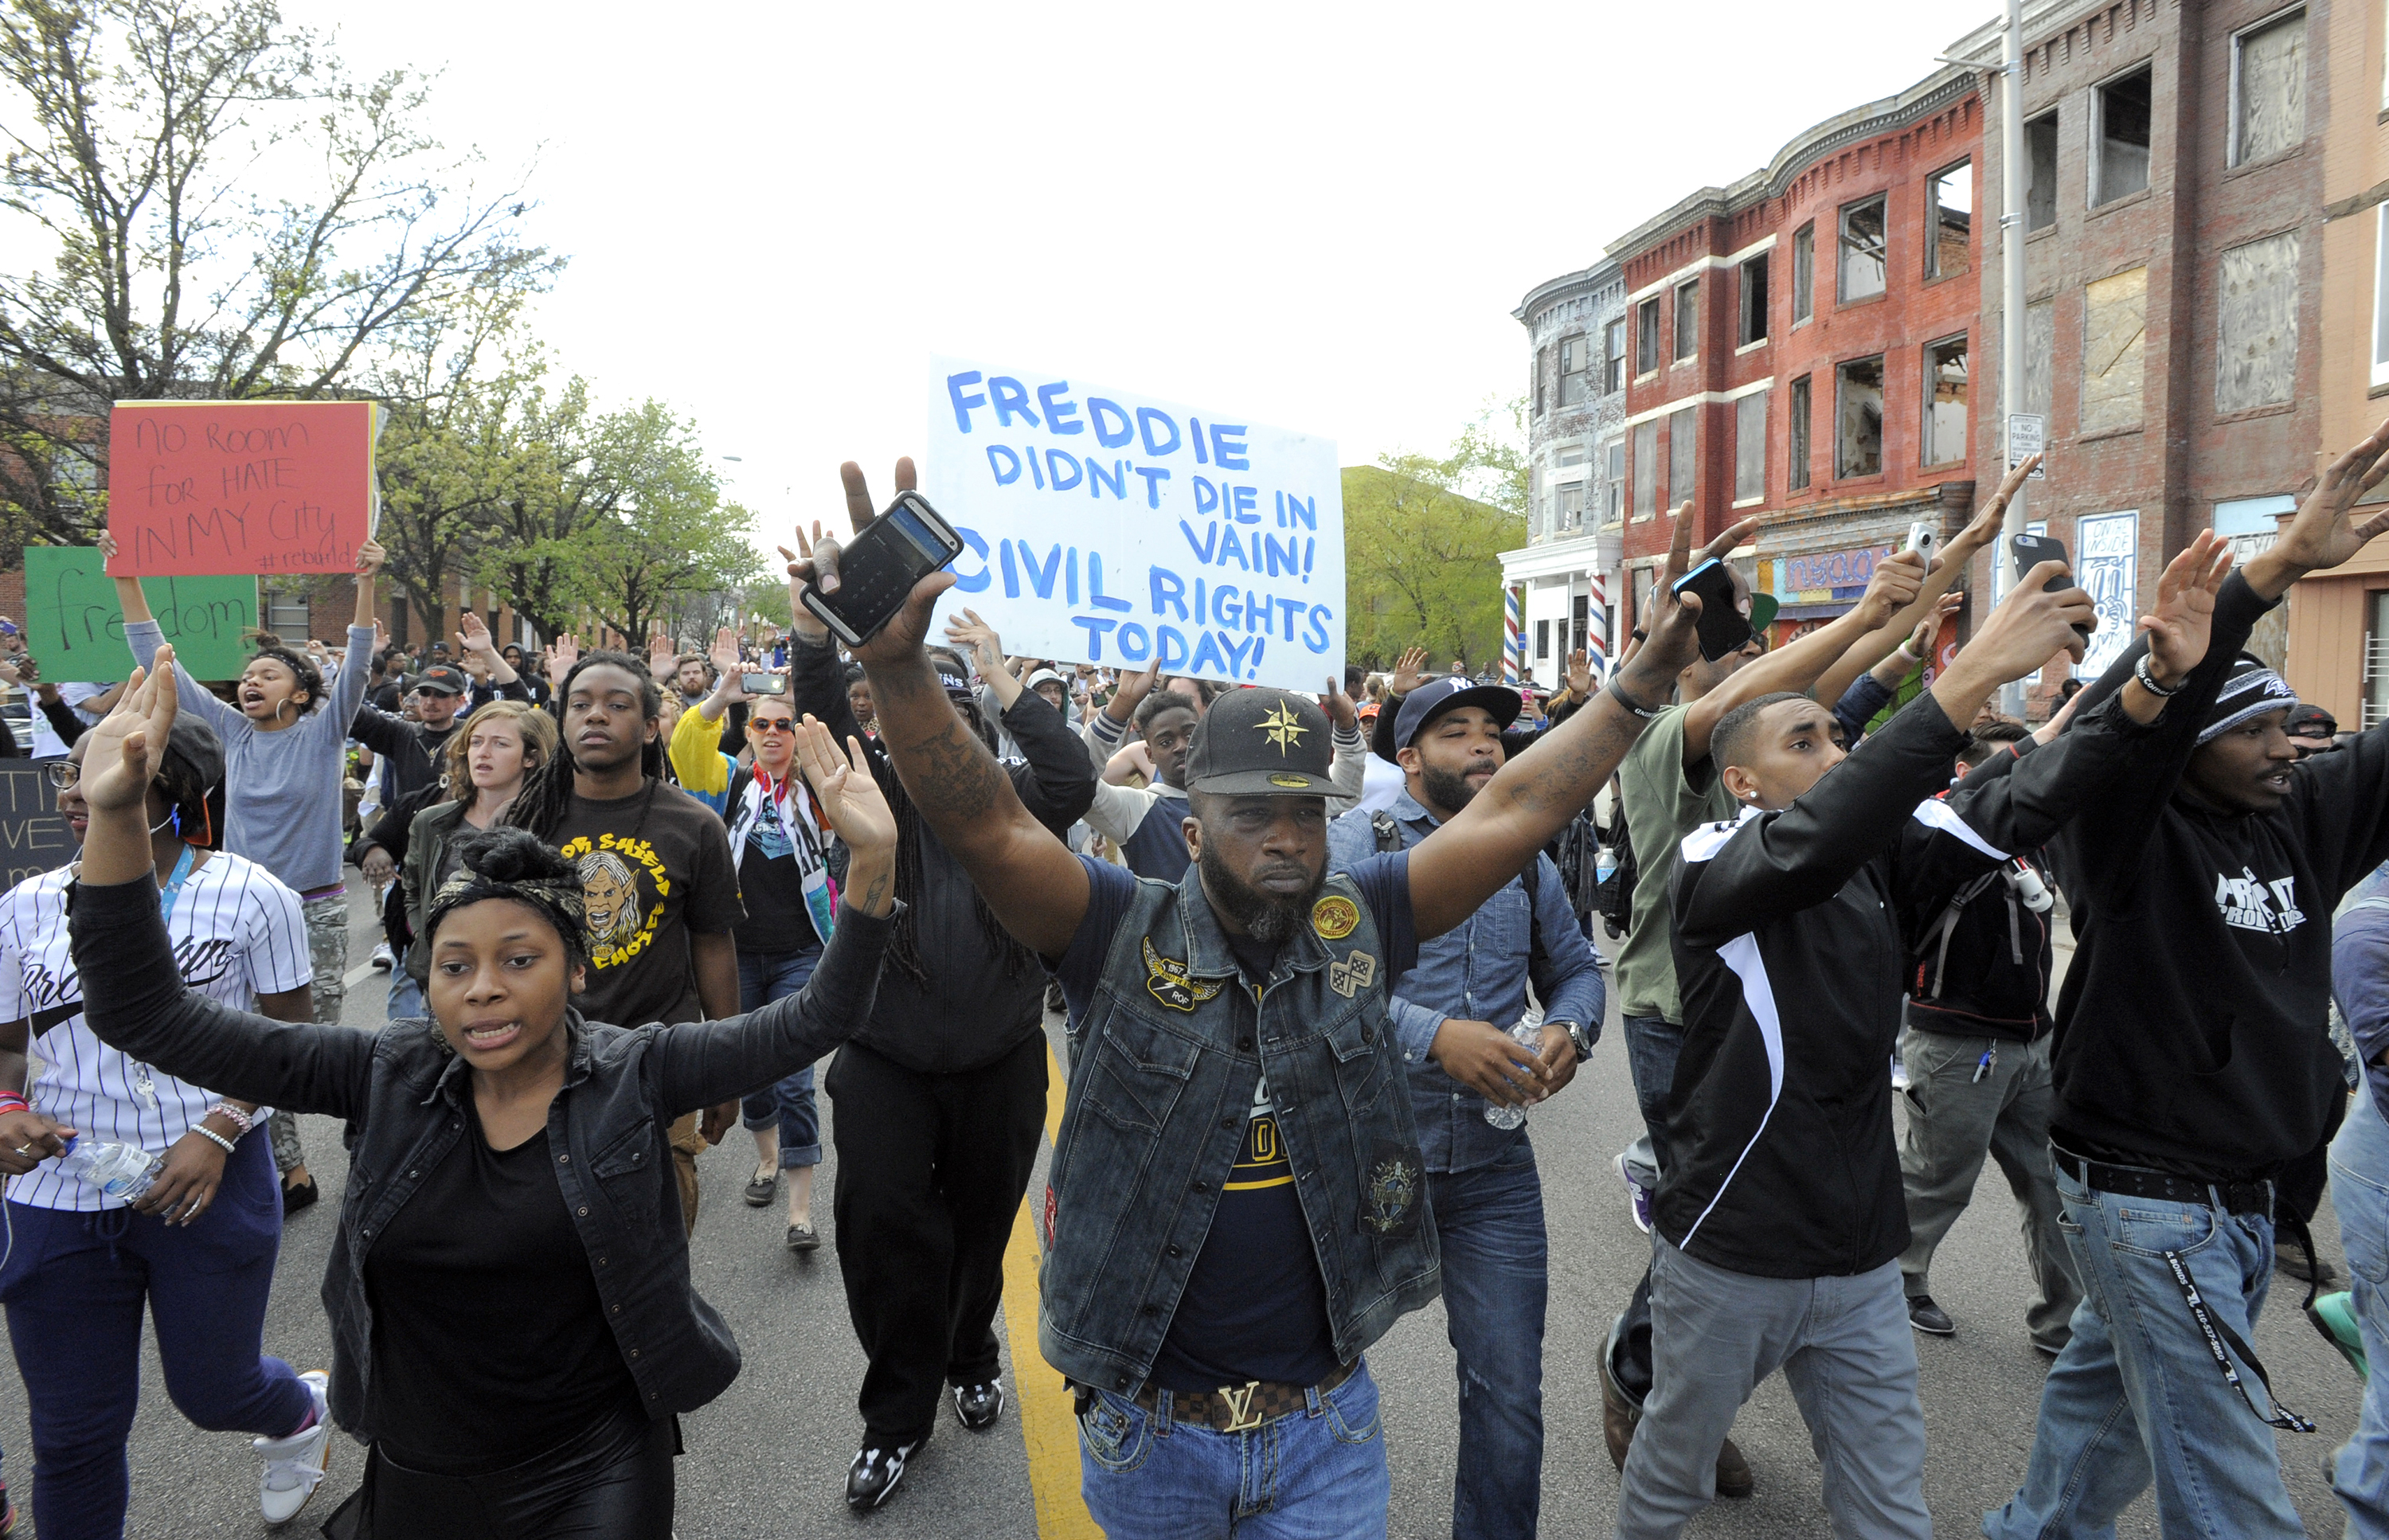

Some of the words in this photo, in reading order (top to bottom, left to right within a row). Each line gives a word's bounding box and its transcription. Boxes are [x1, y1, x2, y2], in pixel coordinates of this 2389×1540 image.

[947, 369, 1251, 471] FREDDIE
[2012, 432, 2041, 443] PARKING
[222, 458, 299, 499] HATE
[986, 444, 1171, 510] DIDN'T
[1191, 475, 1262, 525] DIE
[1275, 490, 1318, 532] IN
[1179, 518, 1316, 585] VAIN!
[2086, 534, 2130, 553] INSIDE
[2094, 522, 2109, 538] ON
[2110, 519, 2129, 536] THE
[941, 526, 1134, 614] CIVIL
[43, 568, 251, 651] fredom
[1148, 564, 1333, 655] RIGHTS
[1071, 616, 1266, 682] TODAY!
[1167, 963, 1184, 975] 1967
[1171, 990, 1190, 1005] ROF
[2169, 1258, 2189, 1285] BONDS
[2195, 1307, 2226, 1361] 410-537-5050
